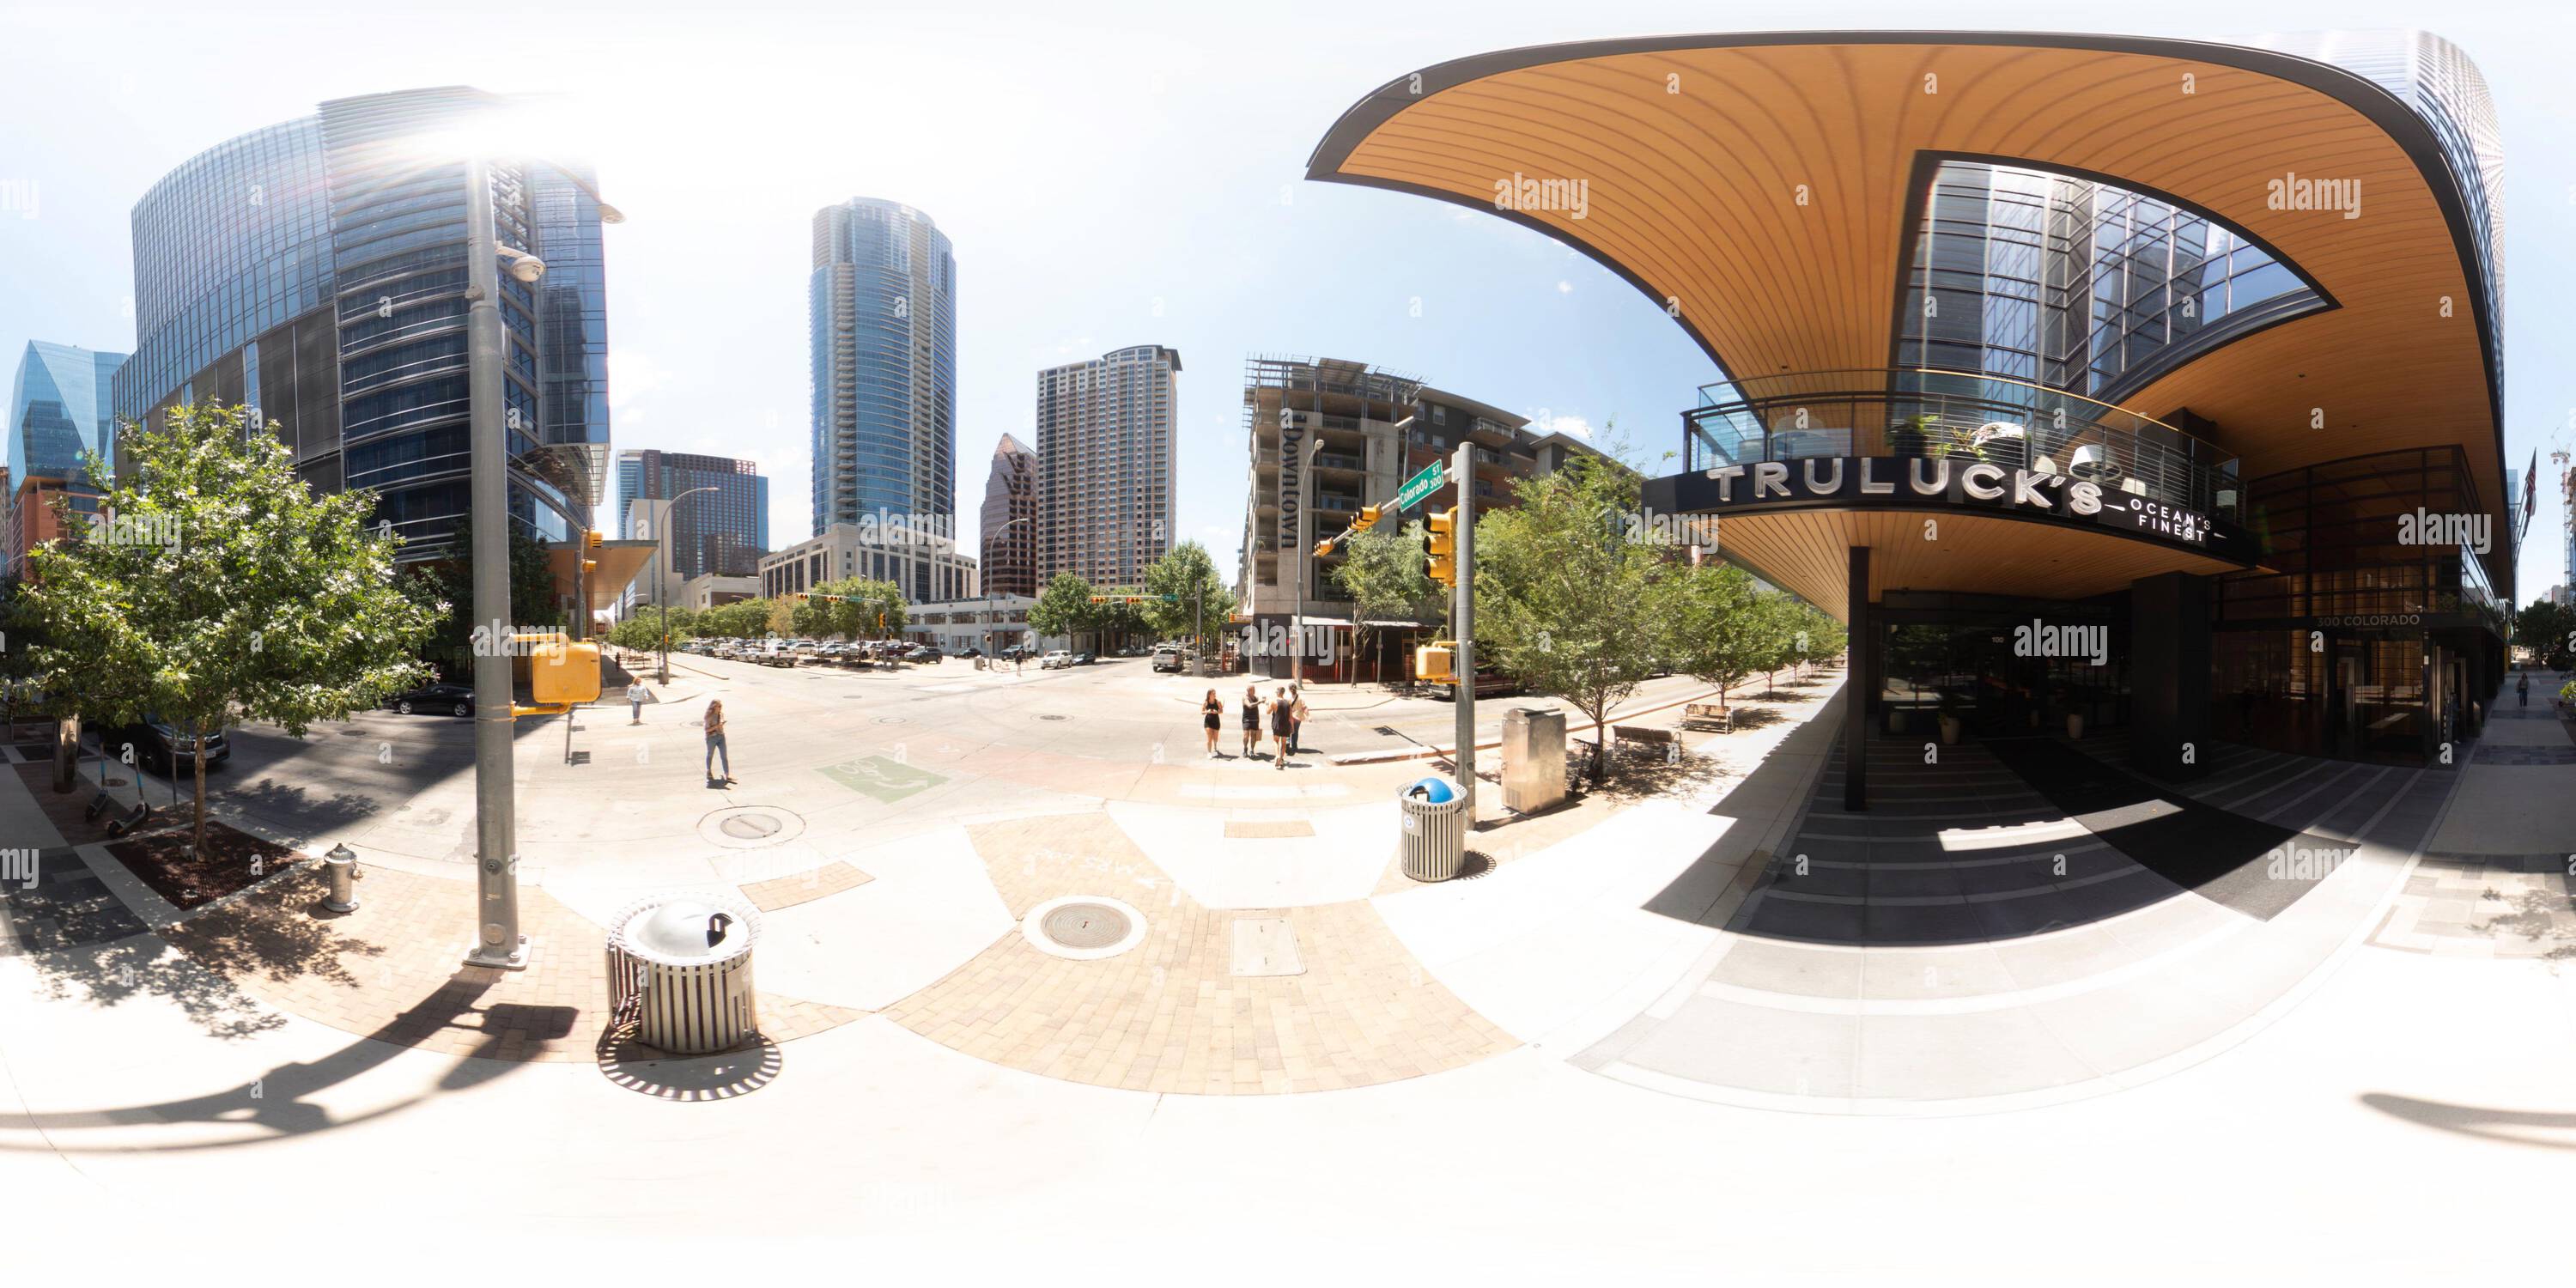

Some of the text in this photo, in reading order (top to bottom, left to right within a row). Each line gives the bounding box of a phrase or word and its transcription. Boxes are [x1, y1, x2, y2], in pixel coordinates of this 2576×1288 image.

[1432, 464, 1440, 476] ST
[1282, 428, 1303, 549] Downtown
[1400, 475, 1442, 505] Colorado 300
[1706, 457, 2103, 515] TRULUCK'S
[2130, 498, 2210, 531] OCEAN'S
[2139, 514, 2204, 542] FINEST
[2317, 614, 2420, 627] 300 COLORADO
